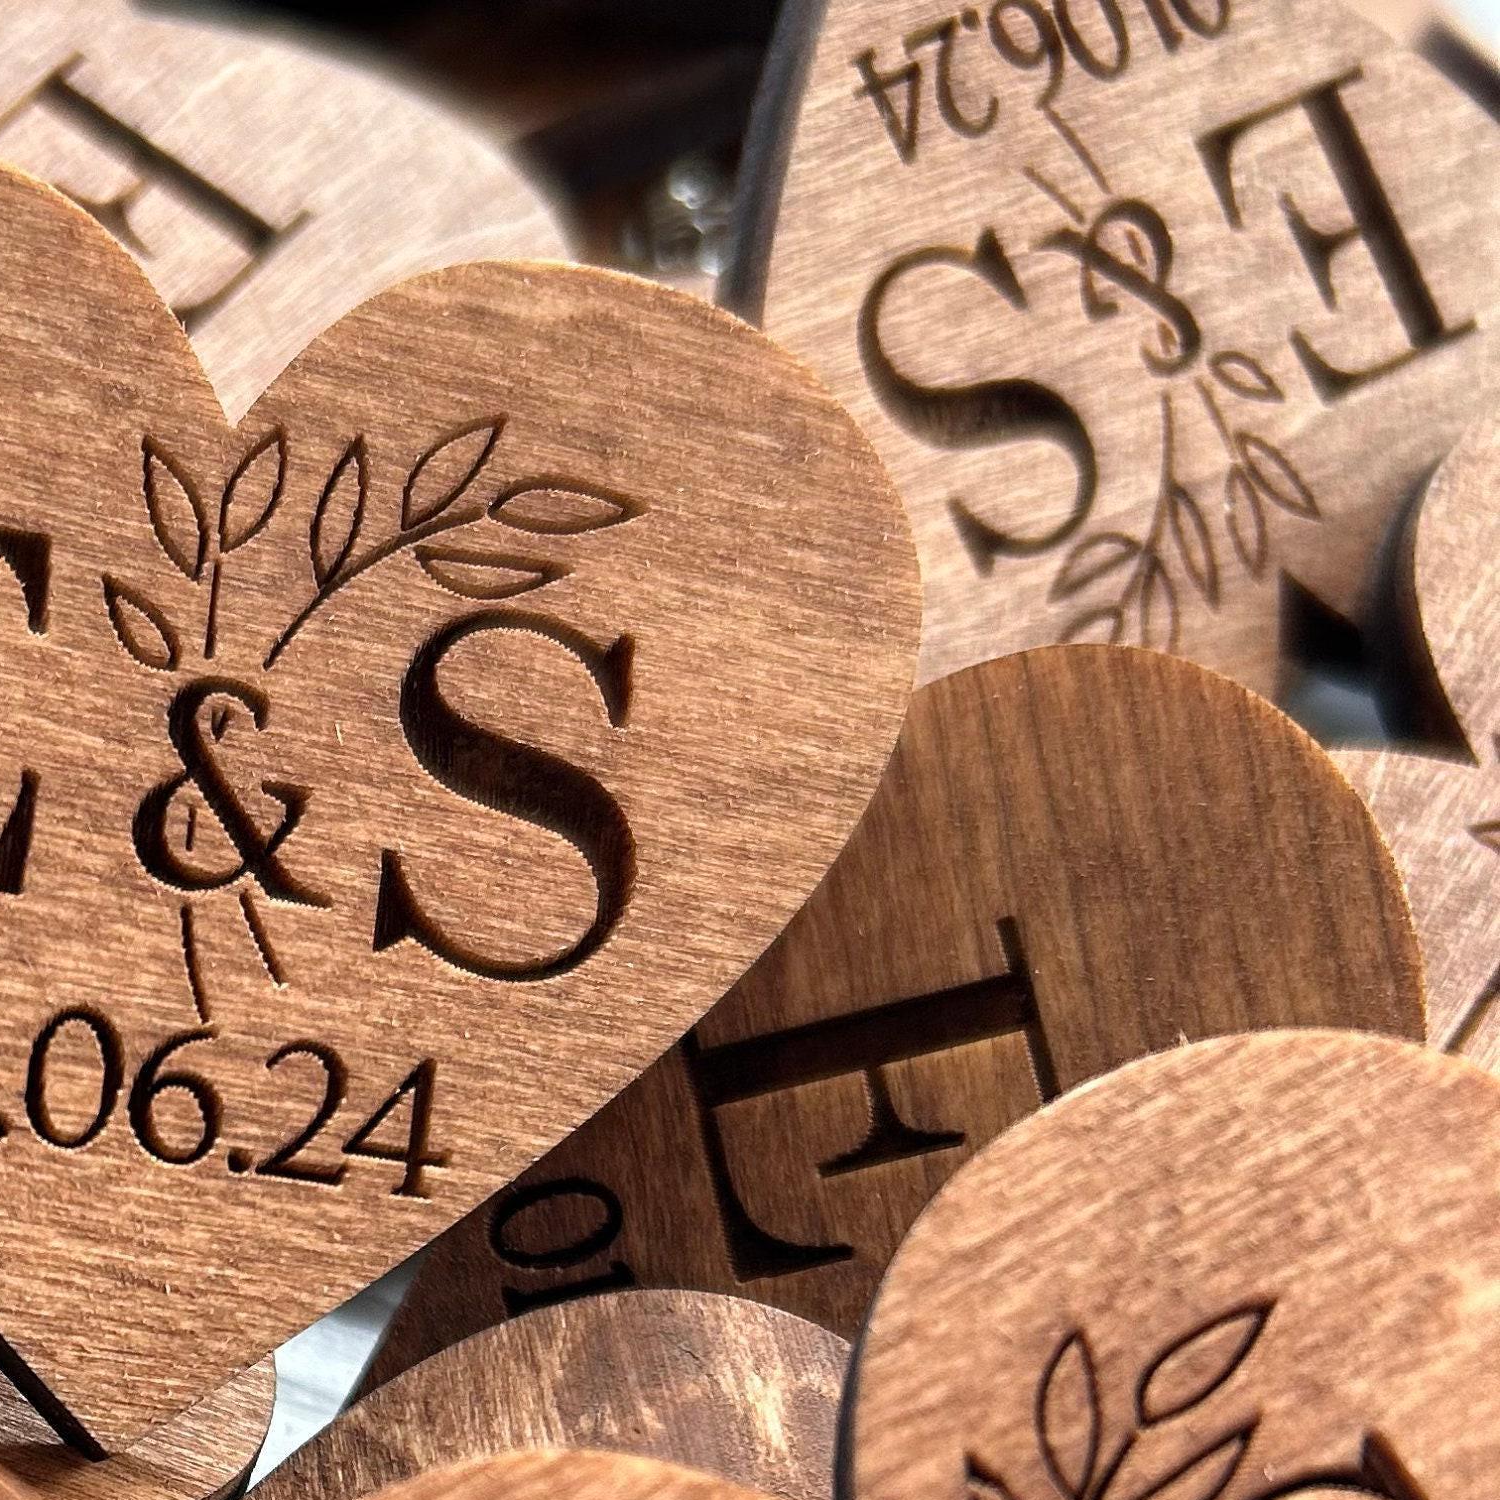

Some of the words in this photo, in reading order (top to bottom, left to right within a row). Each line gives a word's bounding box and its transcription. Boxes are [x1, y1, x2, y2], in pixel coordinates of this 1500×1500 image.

[856, 226, 1099, 578] S
[1035, 198, 1201, 378] &
[1194, 63, 1477, 404] E
[131, 675, 333, 910] &
[372, 607, 638, 984] S
[684, 915, 1061, 1283] E
